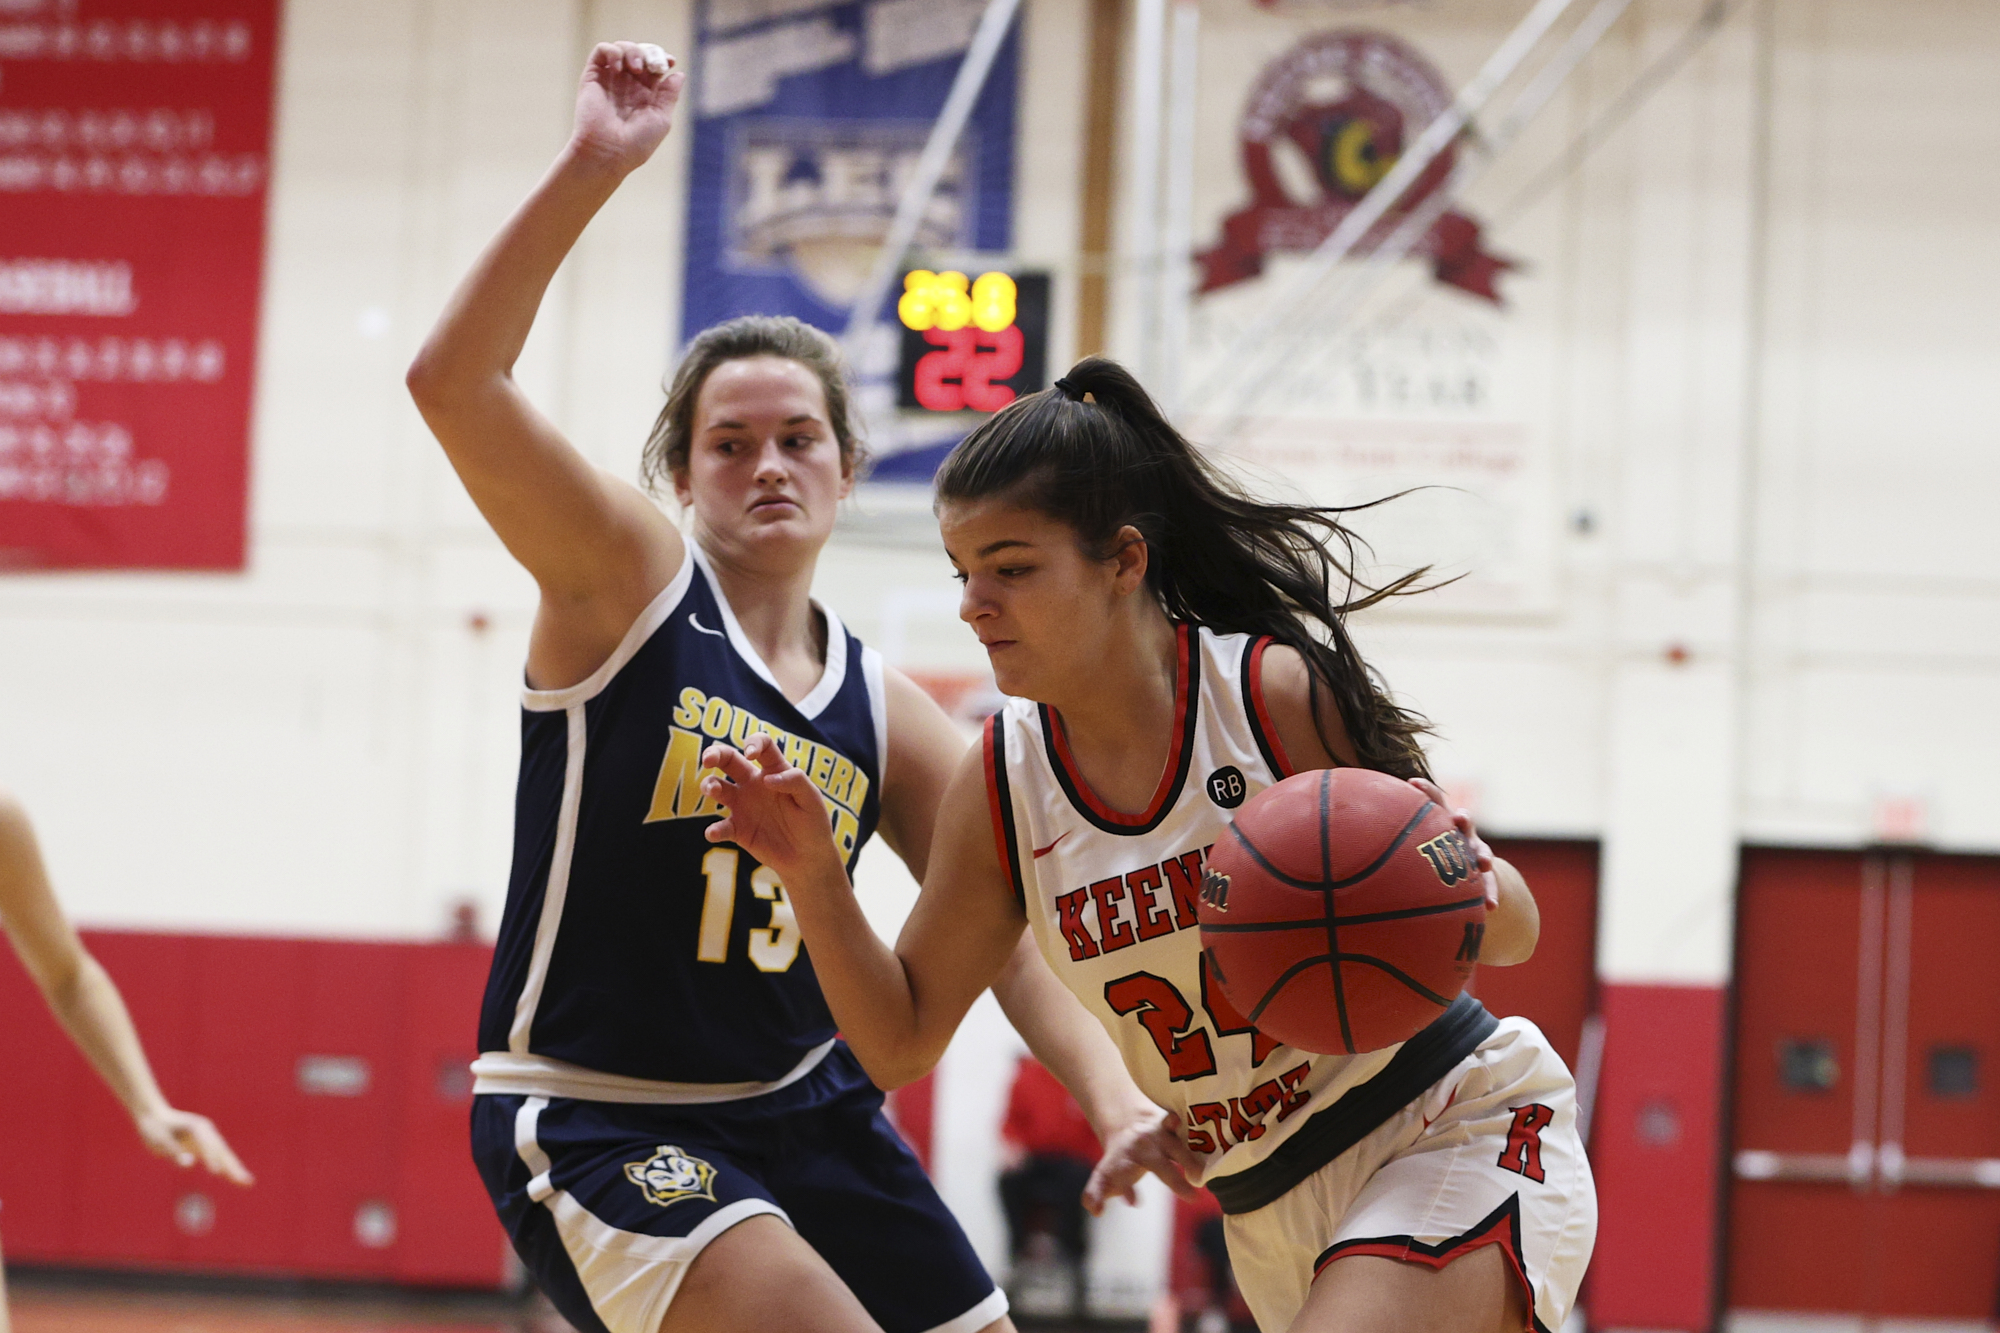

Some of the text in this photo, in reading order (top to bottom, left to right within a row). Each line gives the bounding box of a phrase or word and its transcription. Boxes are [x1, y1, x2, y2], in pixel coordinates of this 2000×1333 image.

[672, 686, 870, 818] SOUTHERN
[1212, 775, 1243, 800] RB
[697, 846, 803, 973] 13
[1055, 841, 1216, 962] KEEN
[1187, 1060, 1312, 1156] STATE
[1496, 1102, 1556, 1185] K
